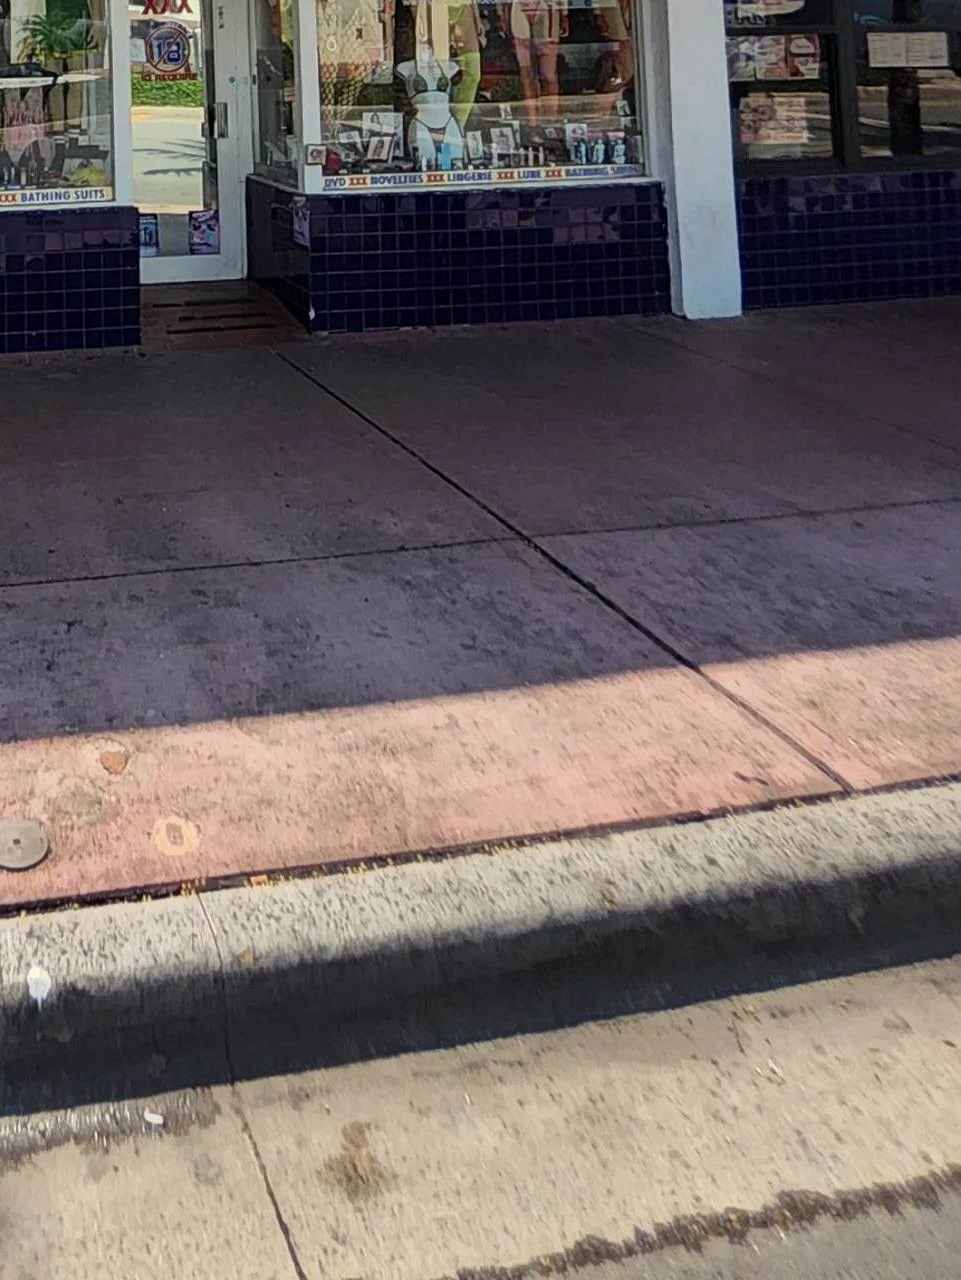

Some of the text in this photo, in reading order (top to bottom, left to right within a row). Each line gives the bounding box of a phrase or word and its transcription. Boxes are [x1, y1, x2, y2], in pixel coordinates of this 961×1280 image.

[155, 38, 183, 65] 18
[324, 177, 346, 188] DVD
[349, 176, 368, 187] XXX
[370, 174, 424, 185] NOVELTIES
[426, 173, 445, 183] XXX
[447, 170, 493, 182] LINGERIE
[496, 170, 515, 180] XXX
[544, 168, 563, 178] XXX
[21, 189, 72, 203] BATHING
[74, 188, 106, 201] SUITS
